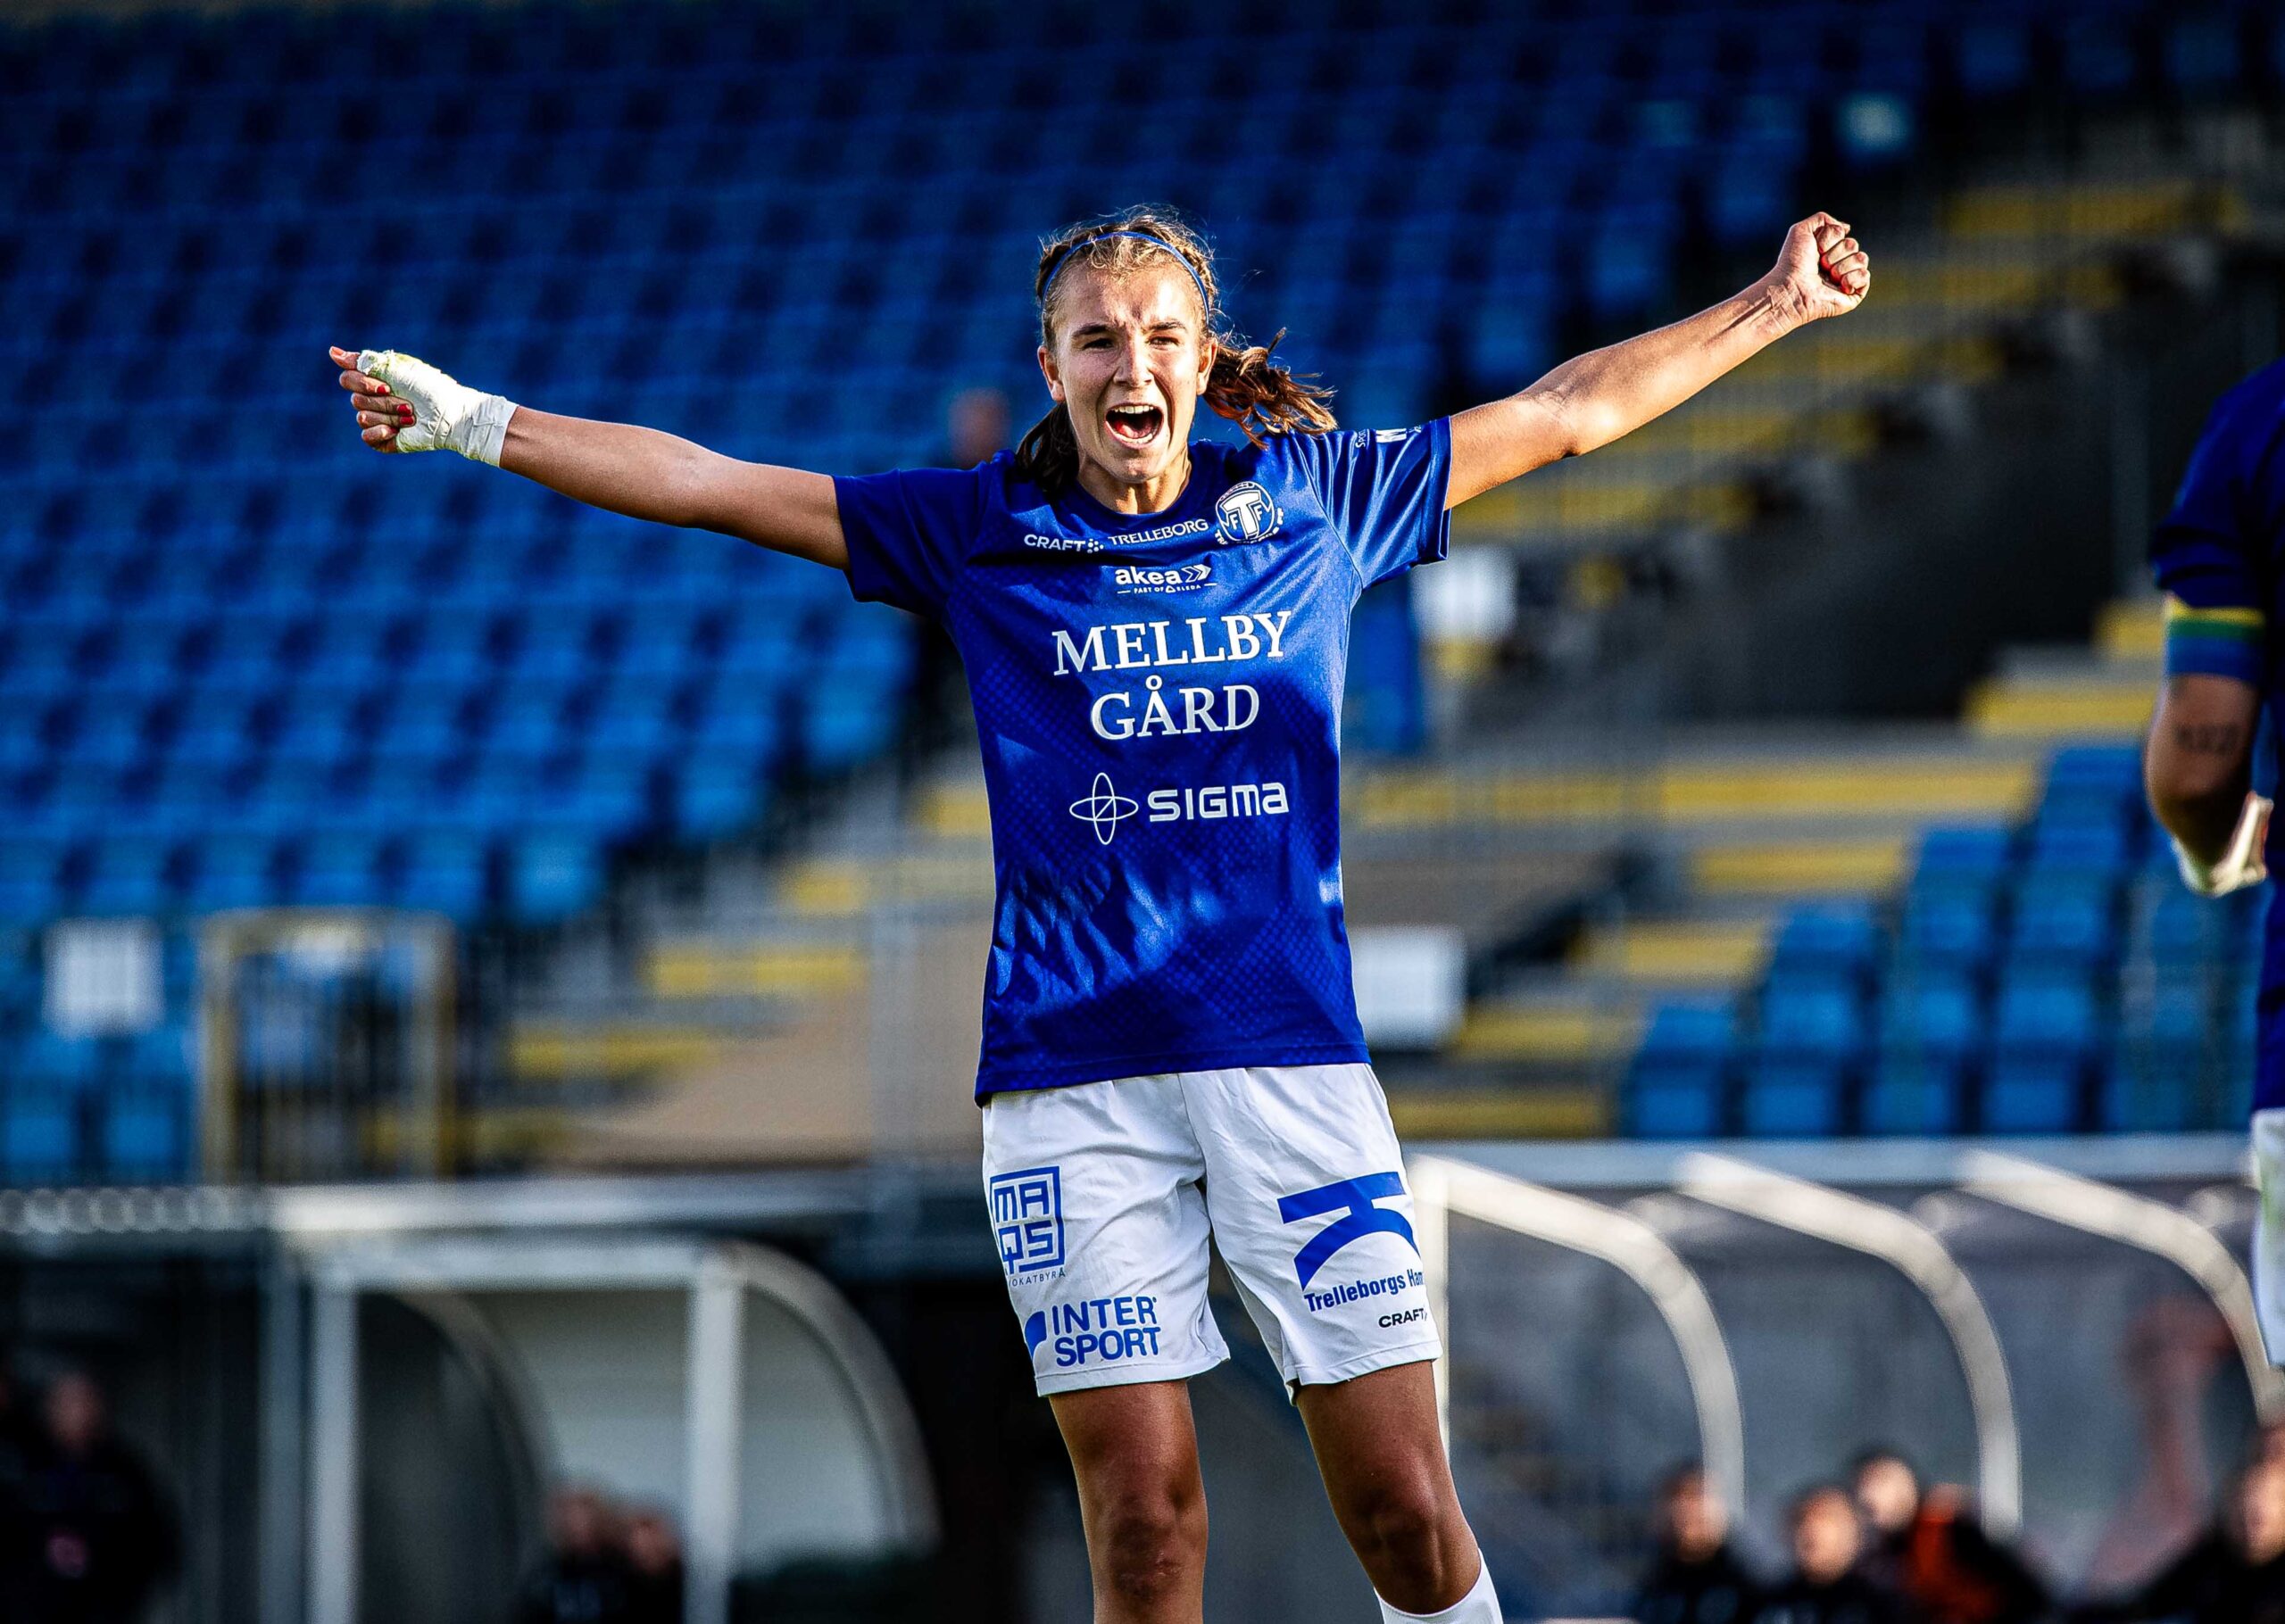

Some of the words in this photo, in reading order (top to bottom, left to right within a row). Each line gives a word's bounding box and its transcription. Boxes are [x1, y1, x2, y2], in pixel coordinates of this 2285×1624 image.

[1024, 534, 1086, 552] CRAFT
[1108, 518, 1209, 545] TRELLEBORG
[1115, 566, 1183, 585] akea
[1051, 610, 1292, 675] MELLBY
[1090, 675, 1260, 740] GÅRD
[1304, 1274, 1407, 1313] Trelleborgs
[1051, 1296, 1158, 1336] INTER
[1378, 1307, 1425, 1328] CRAFT
[1054, 1327, 1161, 1367] SPORT
